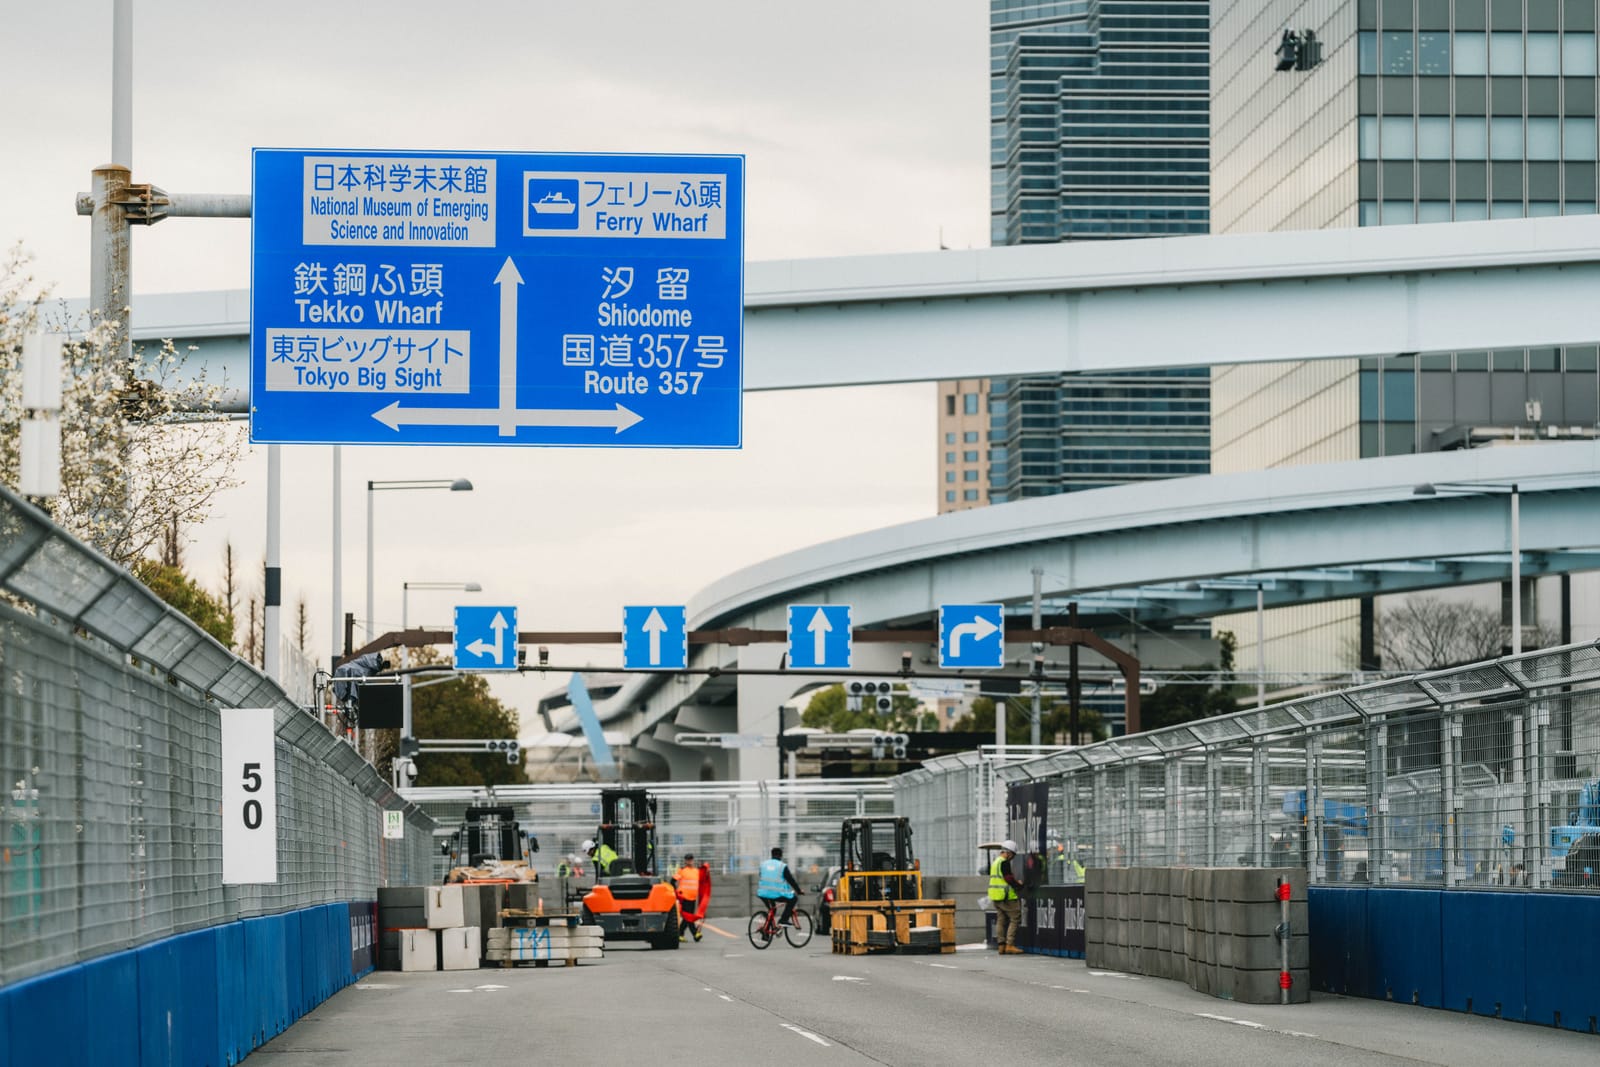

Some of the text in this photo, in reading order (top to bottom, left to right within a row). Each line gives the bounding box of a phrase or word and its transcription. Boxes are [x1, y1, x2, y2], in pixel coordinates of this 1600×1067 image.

[314, 163, 488, 194] 日本科学未来館
[584, 181, 722, 209] フェリーふ頭
[310, 196, 489, 221] National Museum of Emerging
[330, 219, 470, 241] Science and Innovation
[595, 211, 708, 236] Ferry Wharf
[293, 262, 445, 298] 鉄鋼ふ頭
[294, 298, 443, 324] Tekko Wharf
[597, 301, 692, 328] Shiodome
[271, 334, 464, 365] 東京ビッグサイト
[562, 333, 729, 369] 国道357号
[293, 365, 443, 391] Tokyo Big Sight
[584, 370, 704, 395] Route 357
